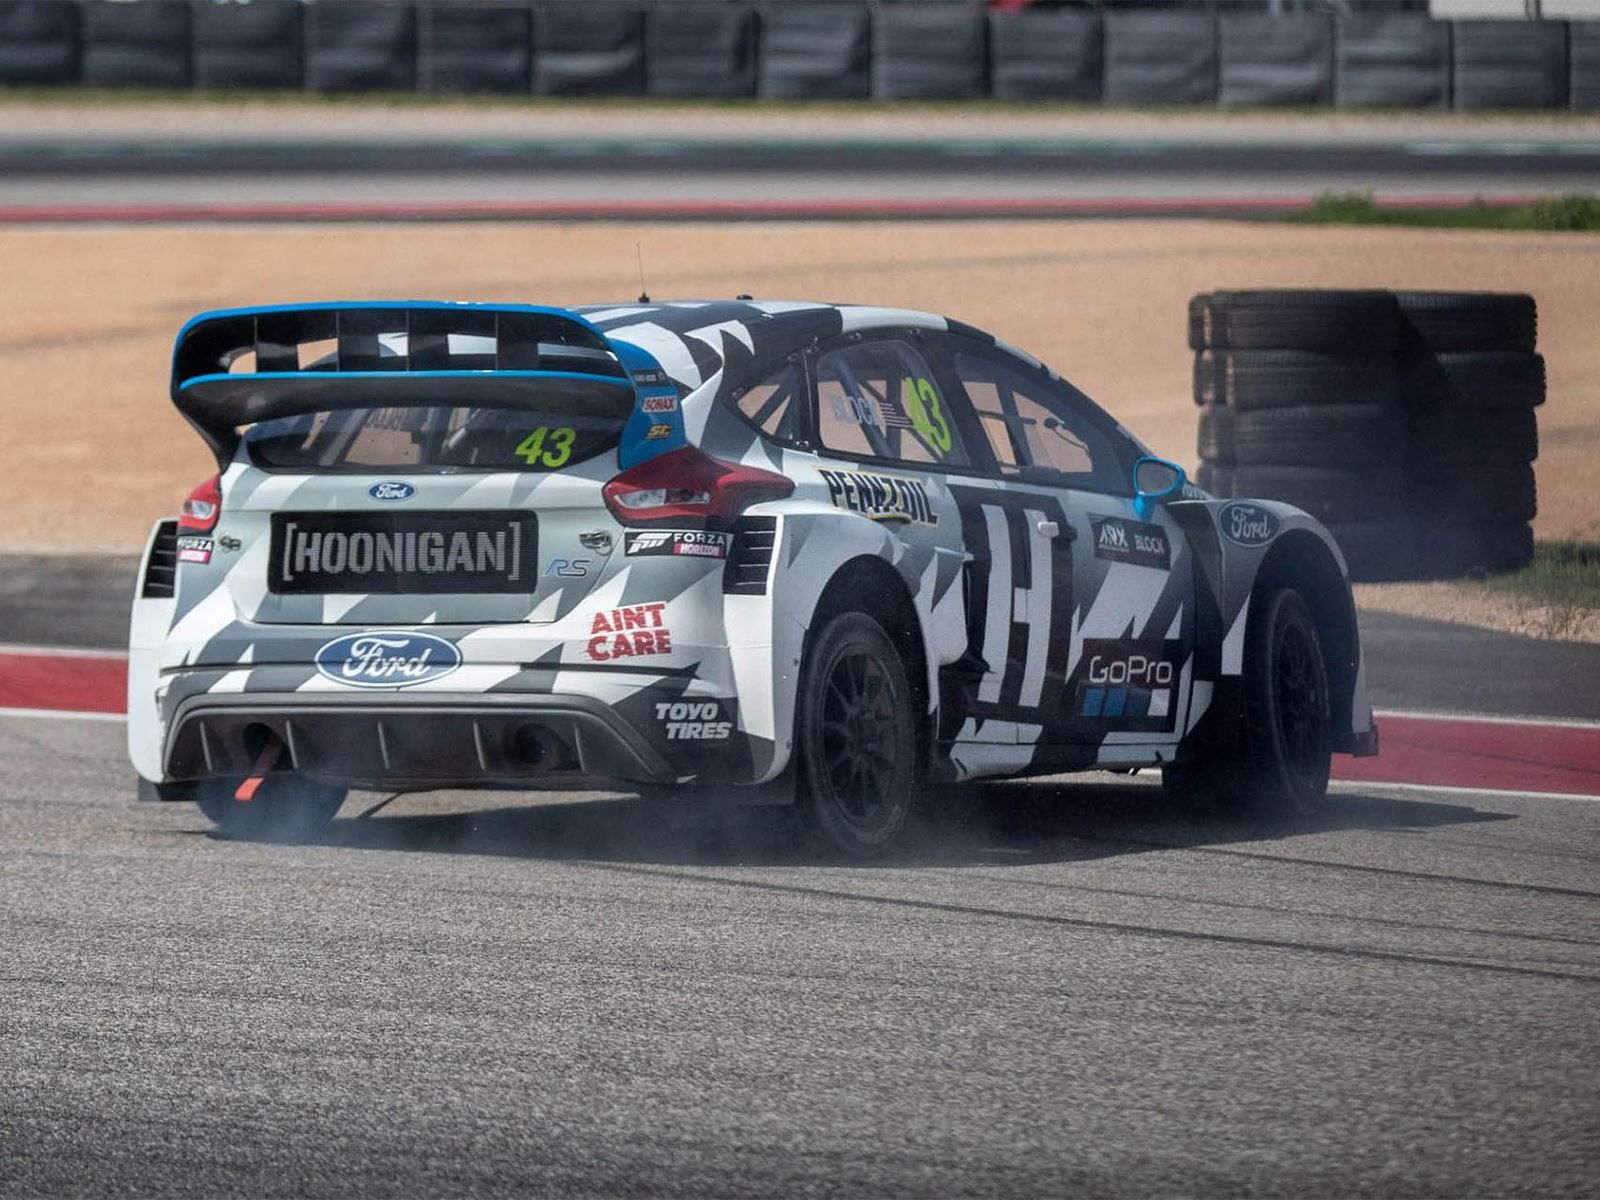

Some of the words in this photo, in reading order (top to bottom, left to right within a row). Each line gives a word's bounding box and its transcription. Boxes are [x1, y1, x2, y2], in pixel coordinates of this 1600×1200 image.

[644, 397, 674, 411] SONAX
[902, 377, 952, 452] 43
[514, 426, 576, 467] 43
[374, 482, 406, 499] Ford
[818, 469, 938, 524] PENNZOIL
[1231, 506, 1271, 539] Ford
[177, 538, 212, 550] FORZA
[673, 532, 725, 544] FORZA
[1134, 533, 1165, 555] BLOCK
[544, 558, 592, 577] RS
[590, 602, 666, 635] AINT
[341, 637, 432, 677] Ford
[586, 629, 672, 662] CARE
[1088, 655, 1173, 684] GoPro
[655, 702, 719, 721] TOYO
[665, 722, 733, 740] TIRES
